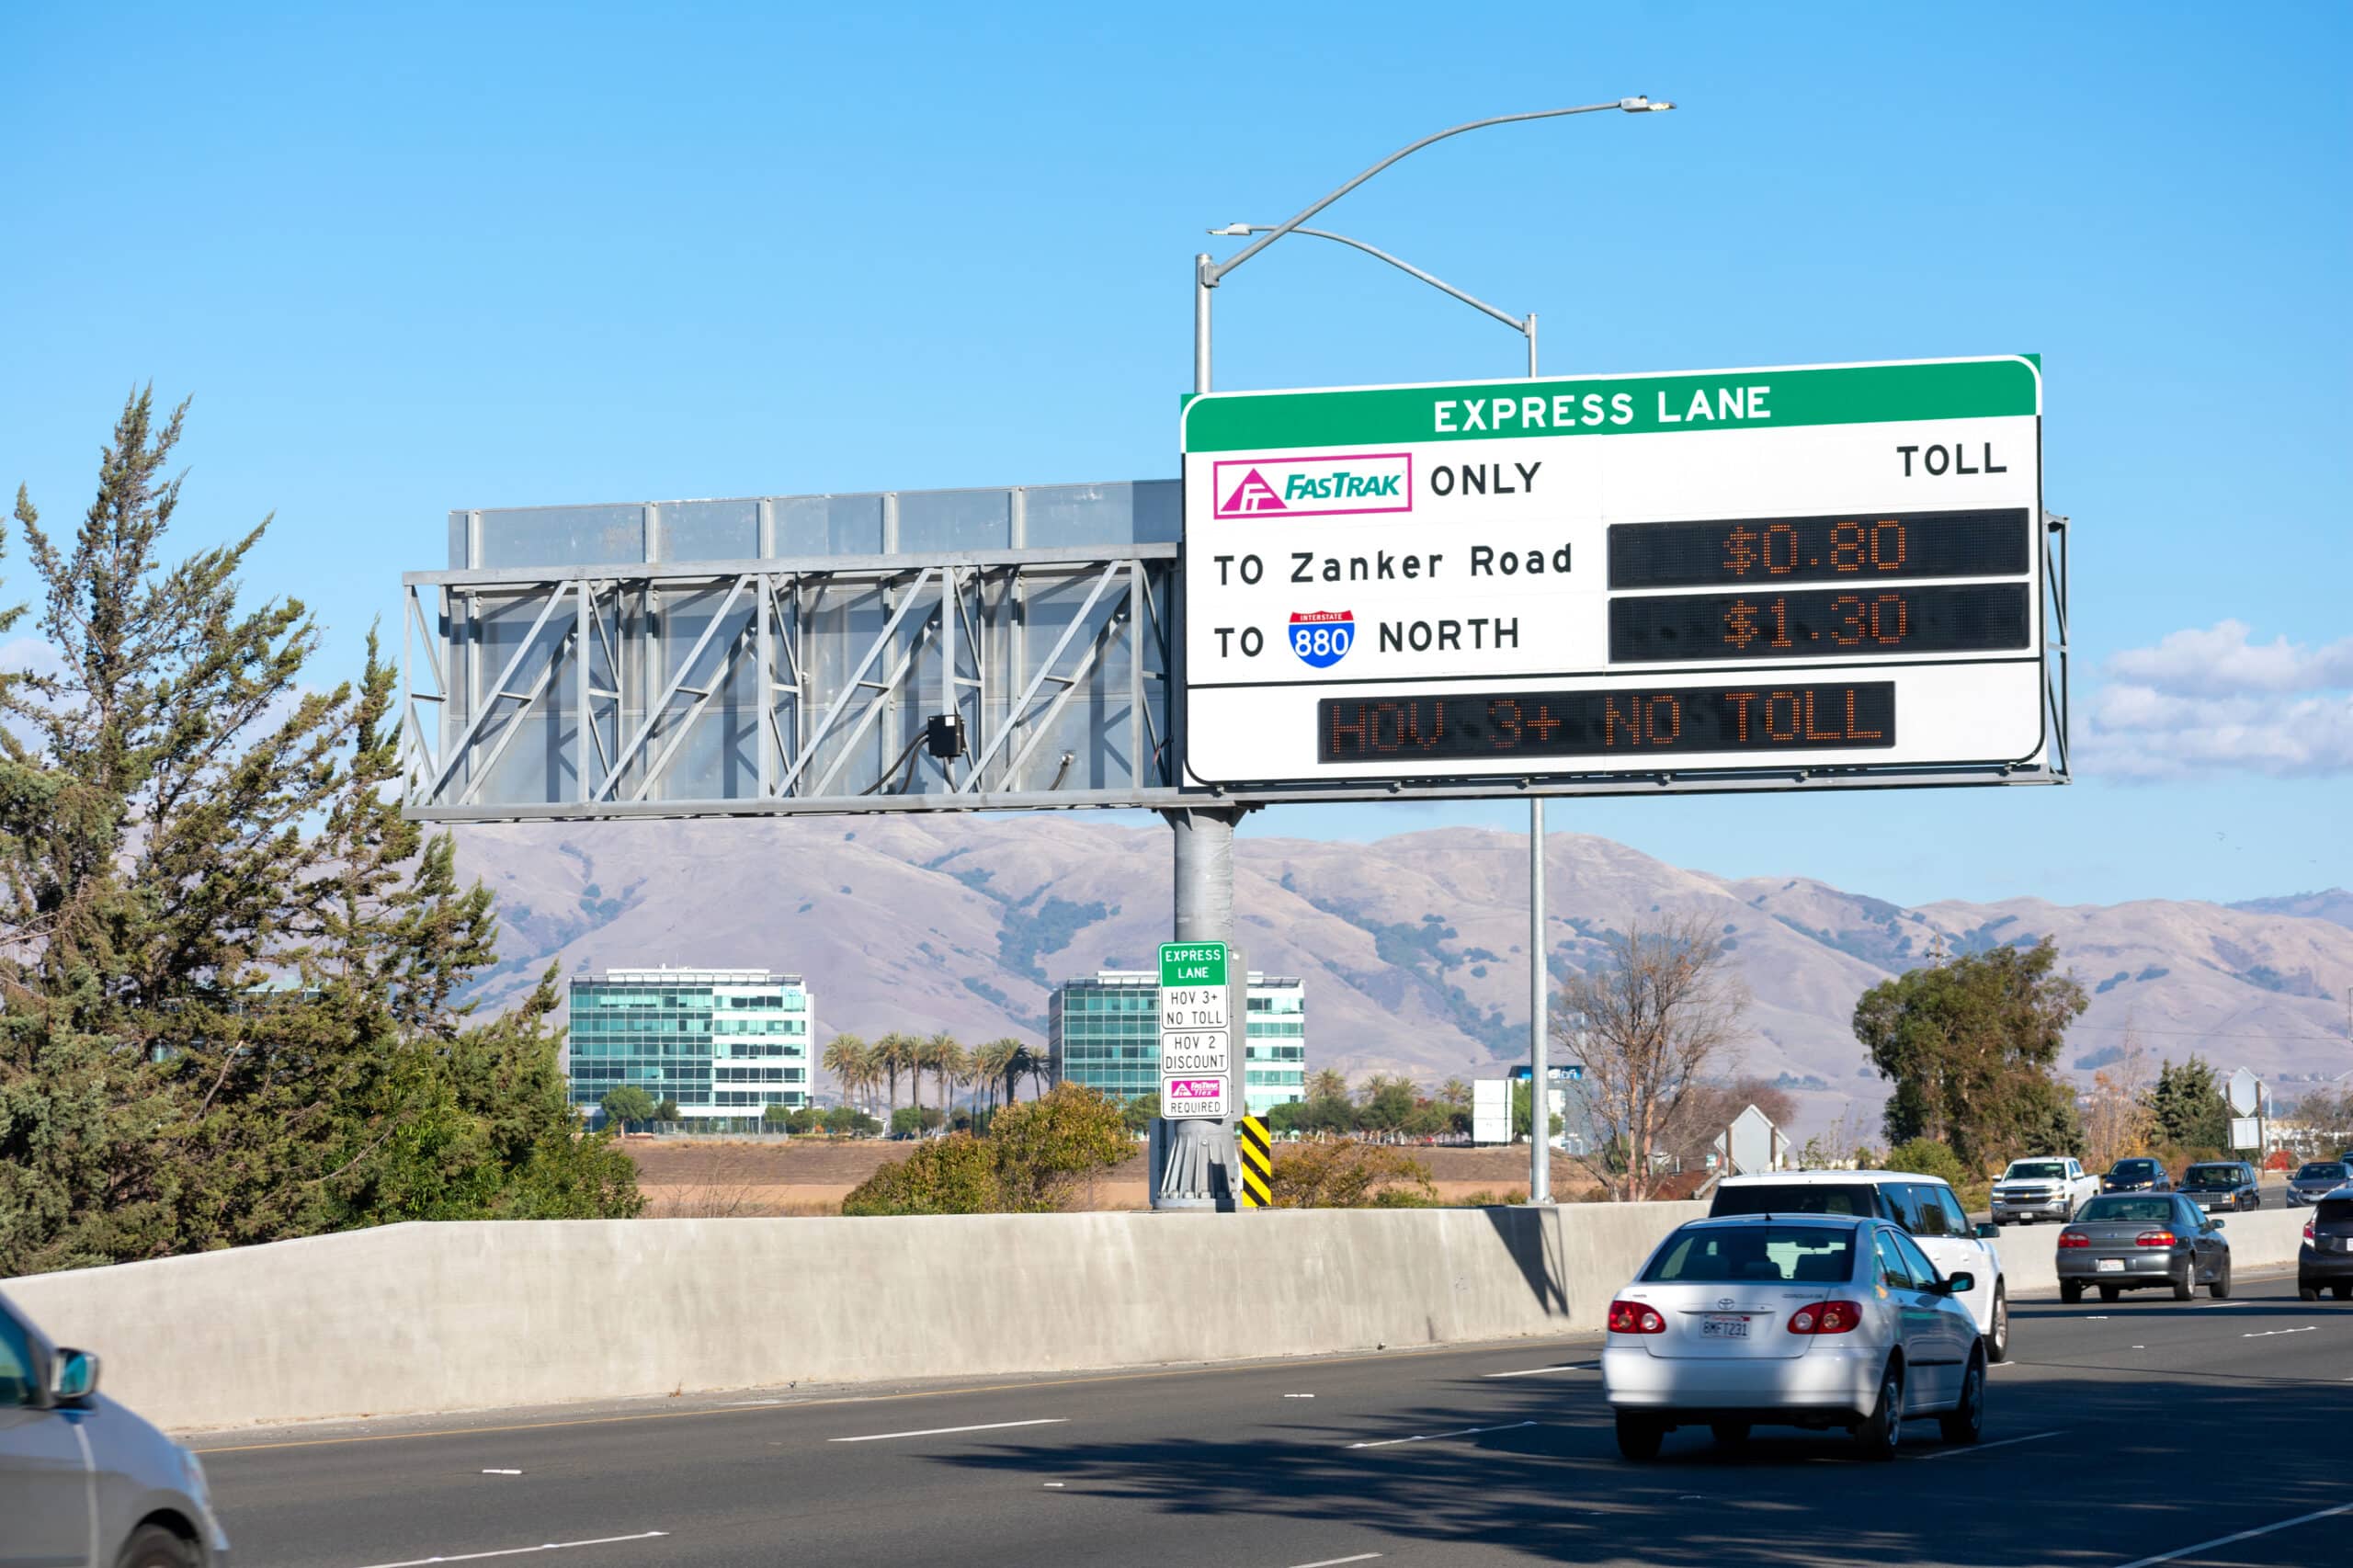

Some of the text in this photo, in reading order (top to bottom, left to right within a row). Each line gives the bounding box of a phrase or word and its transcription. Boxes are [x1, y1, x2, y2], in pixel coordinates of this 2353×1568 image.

[1434, 386, 1771, 432] EXPRESS LANE
[1896, 442, 2007, 477] TOLL
[1430, 461, 1542, 496] ONLY
[1213, 542, 1573, 585] TO Zanker Road
[1723, 519, 1905, 574] $0.80
[1213, 617, 1518, 658] TO 880 NORTH
[1723, 596, 1906, 649] $1.30
[1331, 689, 1882, 754] HOV 3+ NO TOLL
[1165, 949, 1222, 962] EXPRESS
[1177, 967, 1209, 979] LANE
[1171, 991, 1218, 1005] HOV 3+
[1167, 1010, 1222, 1025] NO TOLL
[1175, 1035, 1216, 1050] HOV 2
[1165, 1054, 1225, 1069] DISCOUNT
[1170, 1101, 1221, 1113] REQUIRED
